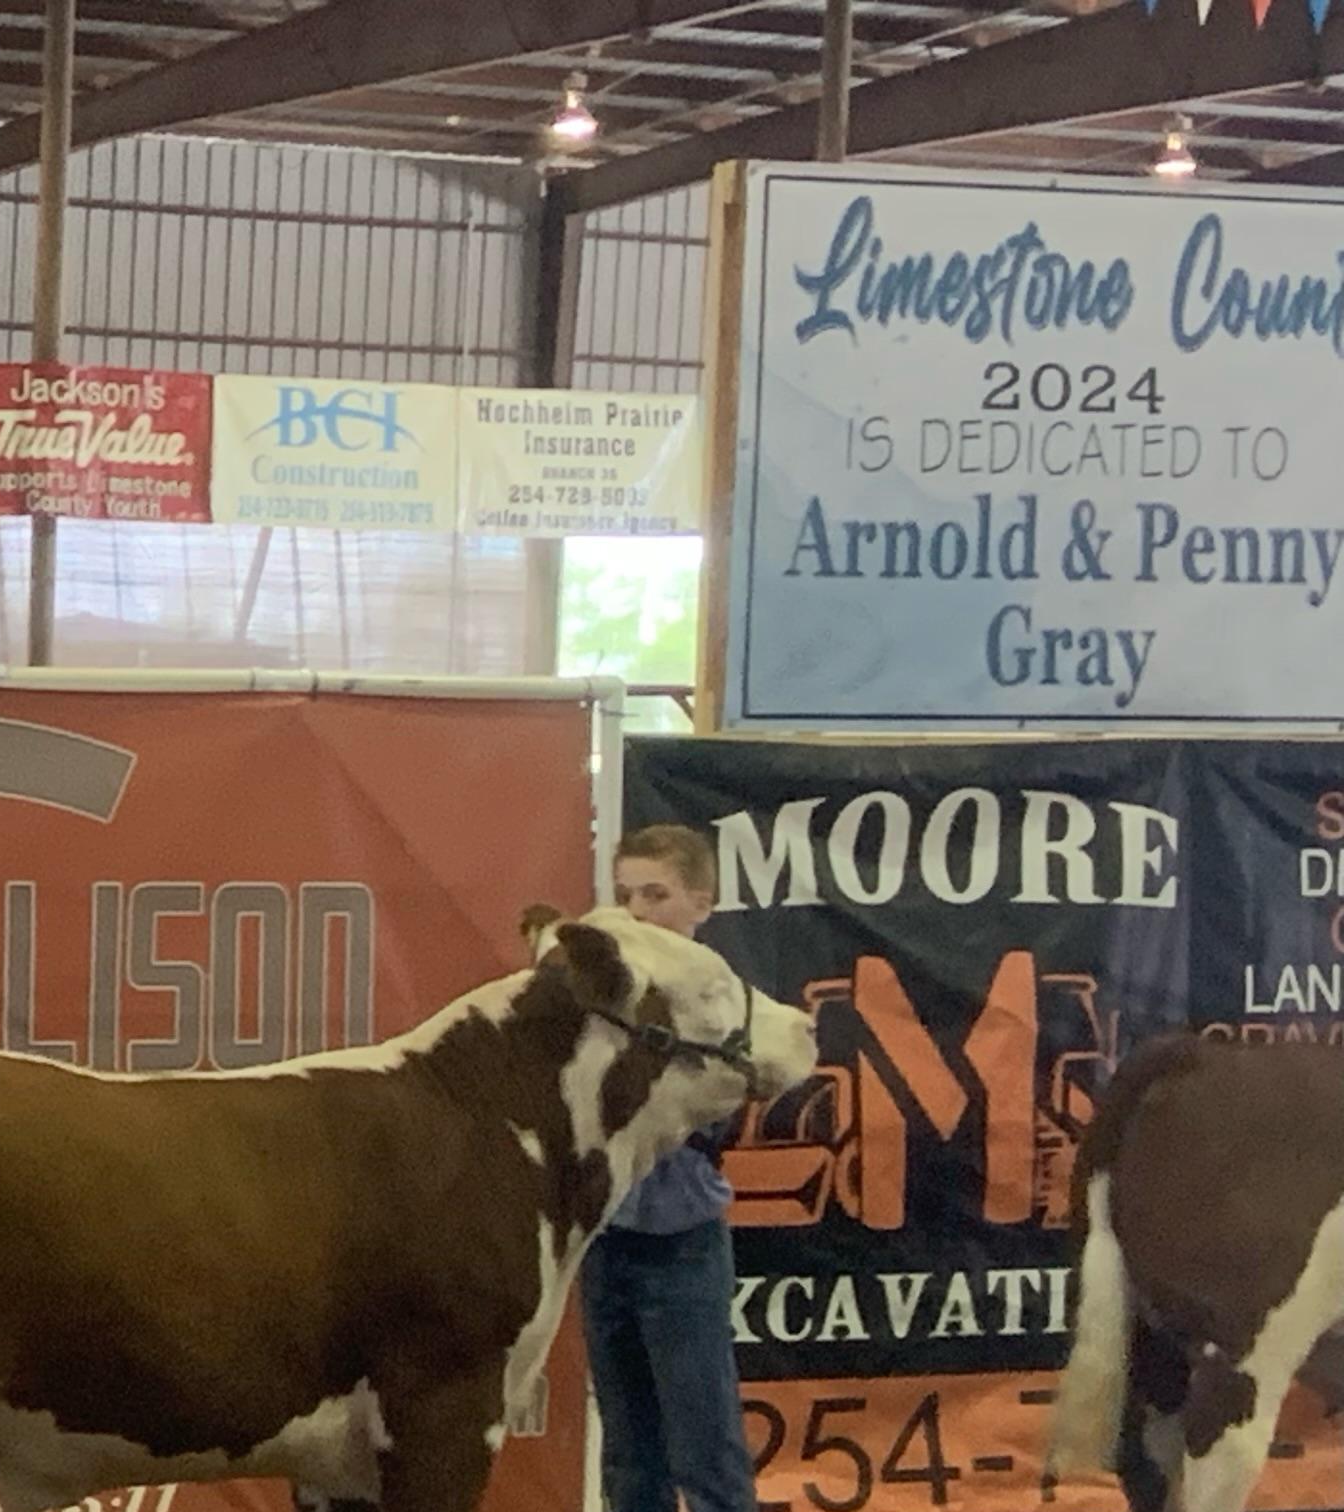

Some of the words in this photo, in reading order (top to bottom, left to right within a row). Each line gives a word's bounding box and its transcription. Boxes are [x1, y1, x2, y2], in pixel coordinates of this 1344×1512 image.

[793, 194, 1134, 347] Limestone
[10, 368, 166, 411] Jackson's
[477, 398, 593, 426] Hochheim
[605, 403, 684, 428] Prairie
[980, 361, 1167, 416] 2024
[276, 385, 404, 453] BCI
[524, 430, 637, 456] Insurance
[846, 416, 894, 474] IS
[919, 418, 1202, 479] DEDICATED
[1224, 426, 1289, 481] TO
[250, 454, 420, 490] Construction
[25, 491, 93, 516] County
[103, 494, 161, 517] Youth
[783, 493, 1040, 579] Arnold
[1061, 498, 1115, 584] &
[1133, 502, 1344, 608] Penny
[984, 603, 1157, 708] Gray
[711, 788, 1180, 914] MOORE
[1299, 848, 1344, 897] D
[854, 950, 1037, 1230] M
